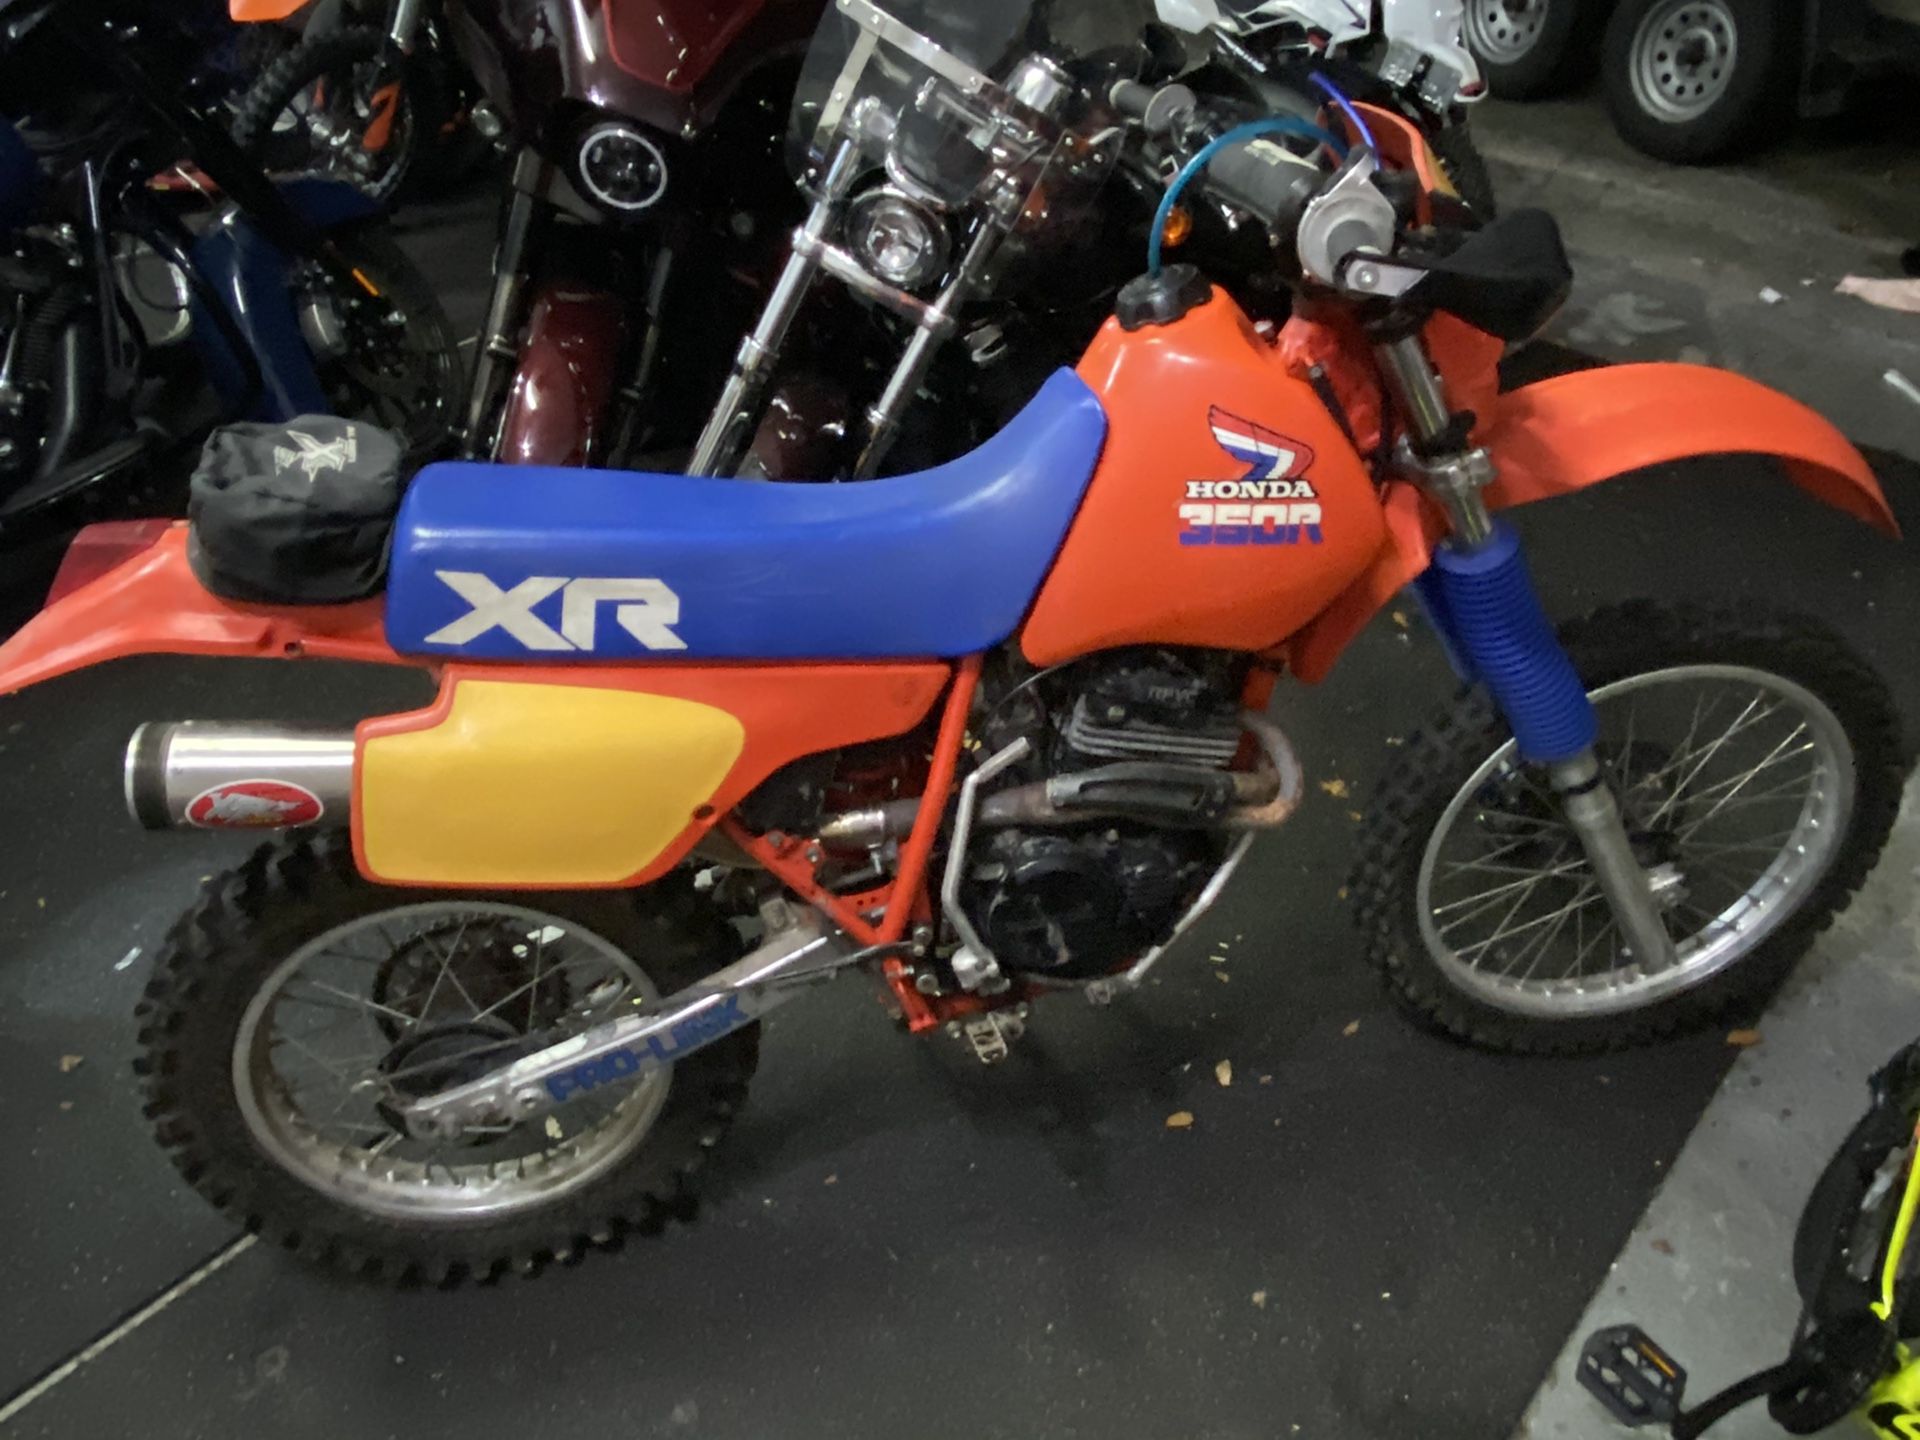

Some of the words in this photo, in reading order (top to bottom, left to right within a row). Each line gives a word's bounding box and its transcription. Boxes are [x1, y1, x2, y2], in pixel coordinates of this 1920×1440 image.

[1185, 480, 1316, 499] HONDA
[1178, 503, 1323, 545] 350R
[424, 570, 688, 651] XR
